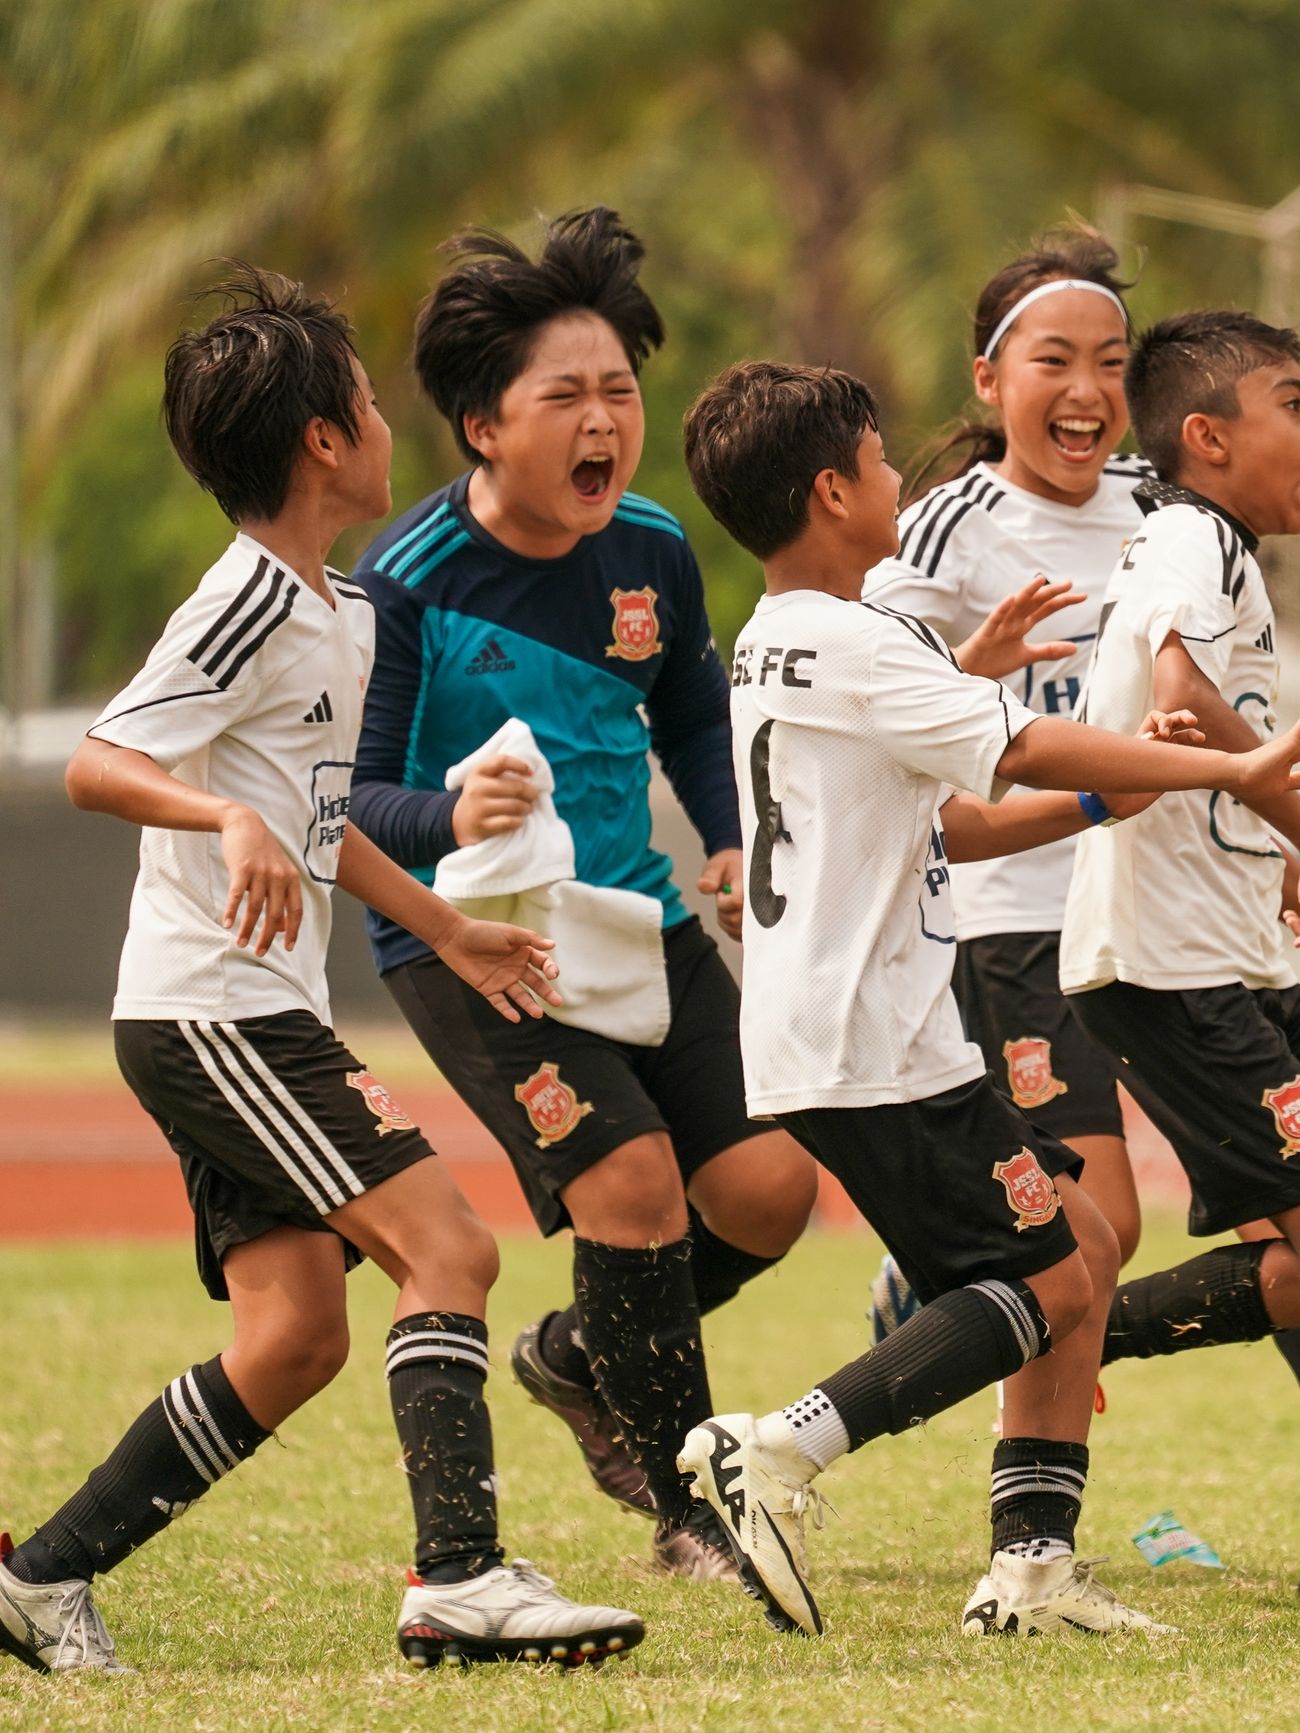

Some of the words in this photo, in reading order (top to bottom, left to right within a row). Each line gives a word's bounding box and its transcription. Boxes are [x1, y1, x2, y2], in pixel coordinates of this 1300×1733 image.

[464, 660, 516, 676] adidas
[759, 647, 817, 689] FC
[1013, 1167, 1041, 1192] JSSL
[1025, 1181, 1041, 1197] FC
